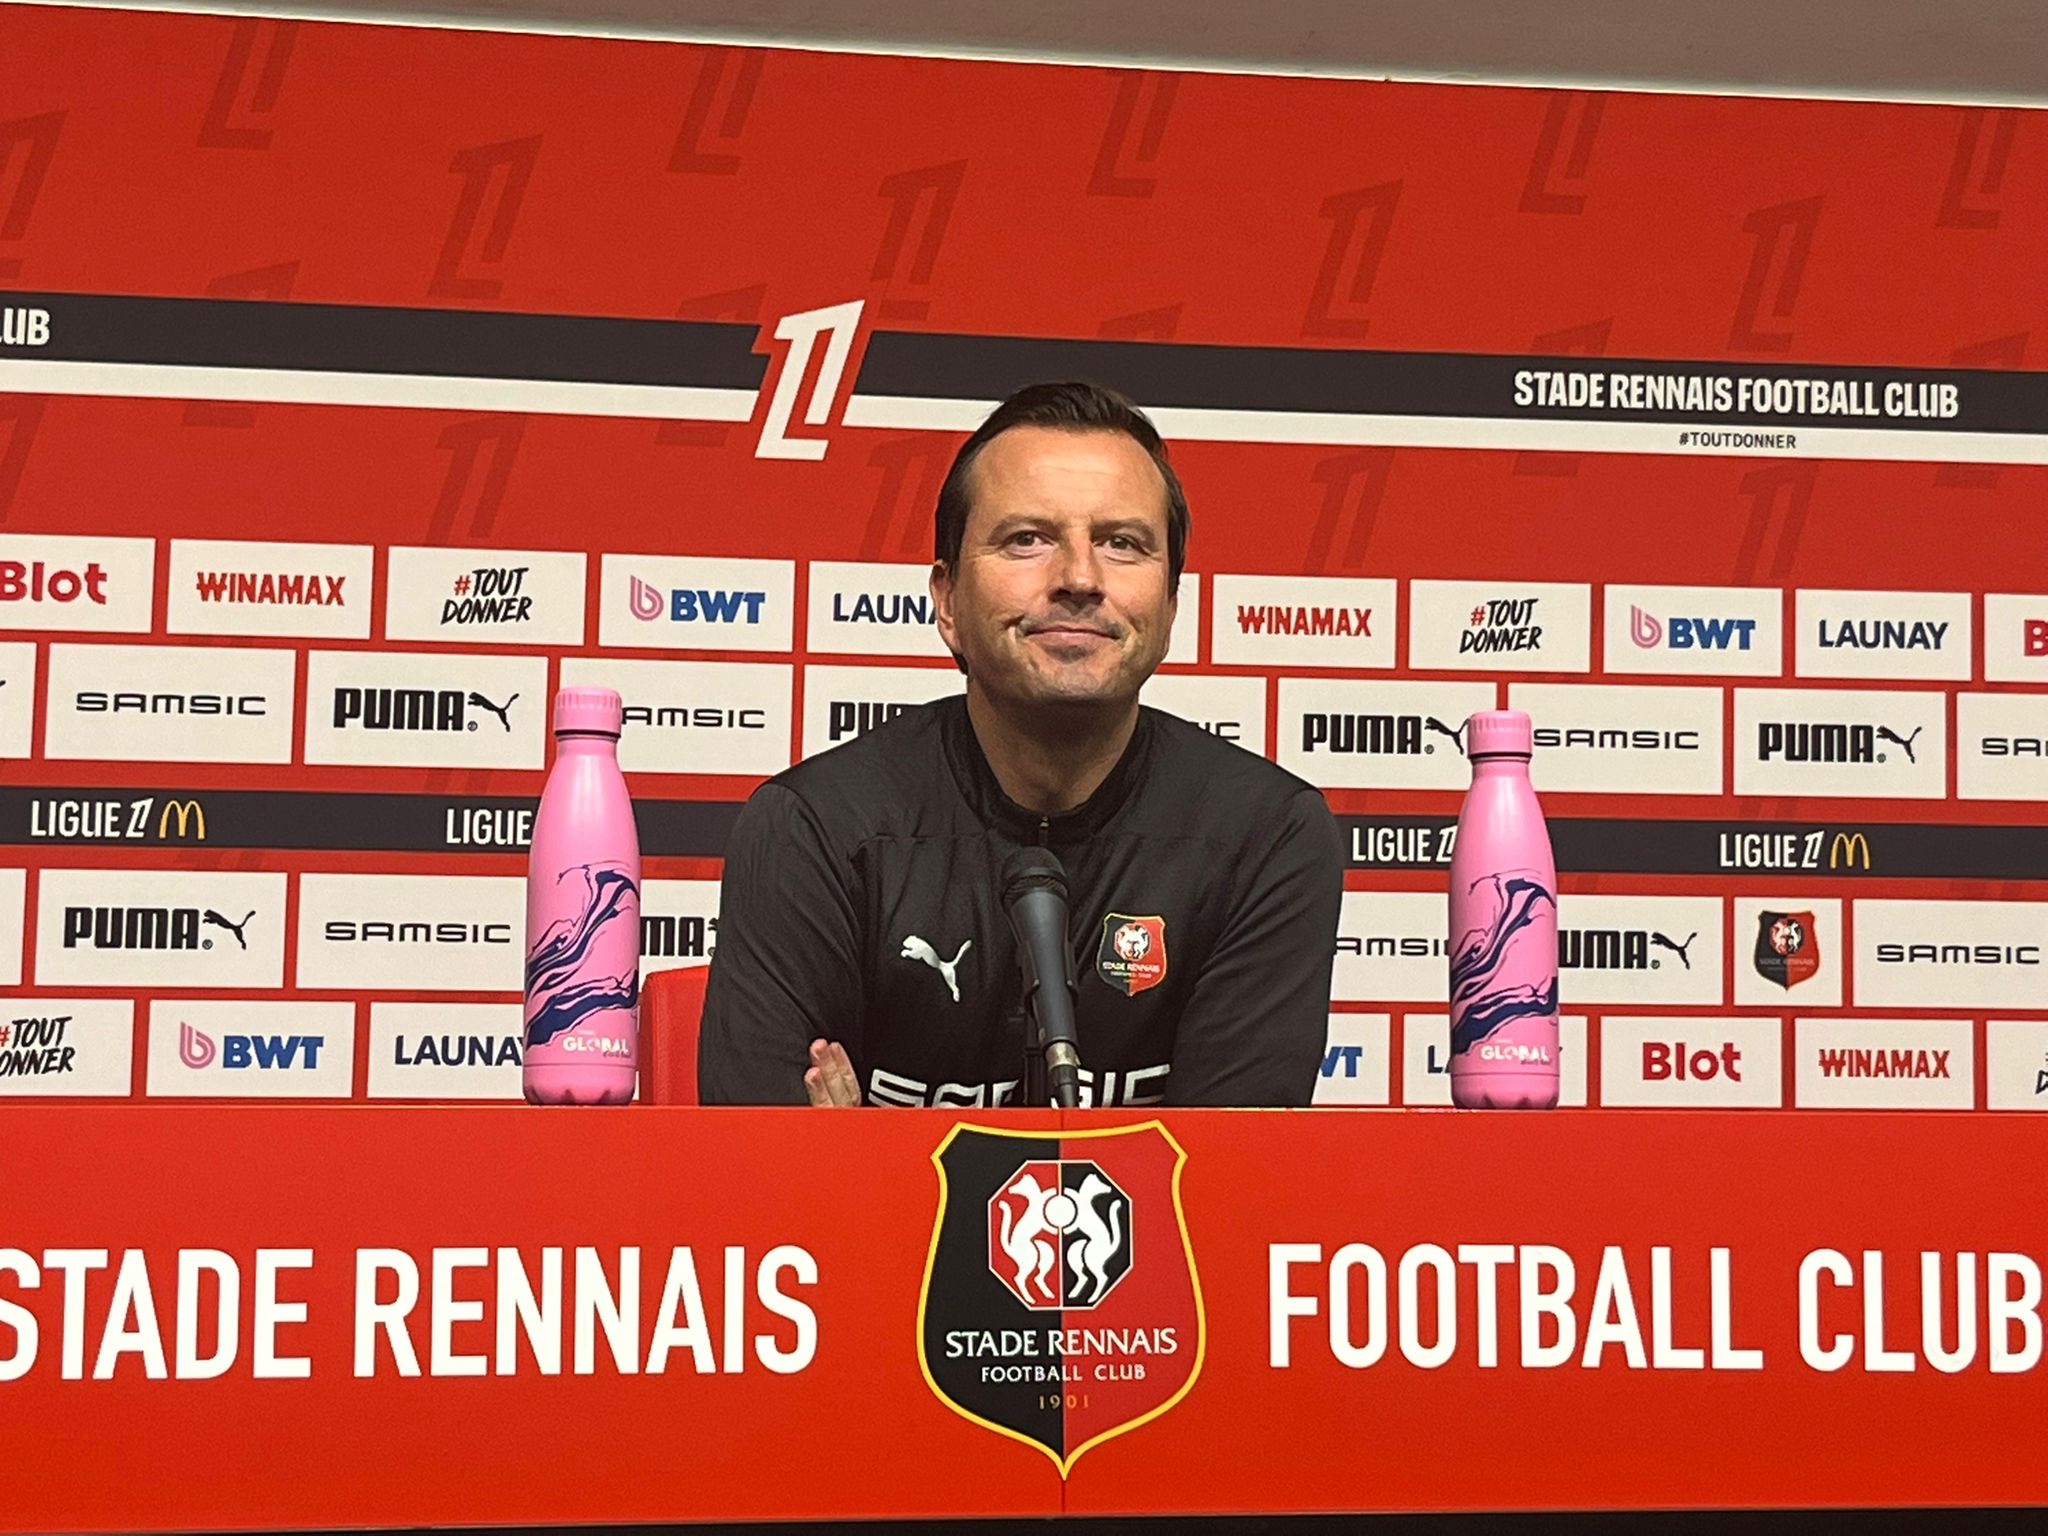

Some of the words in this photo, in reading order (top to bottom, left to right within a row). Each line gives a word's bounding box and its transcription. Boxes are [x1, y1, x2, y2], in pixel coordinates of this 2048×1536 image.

[0, 308, 50, 345] UB
[1514, 370, 1605, 408] STADE
[1609, 373, 1734, 412] RENNAIS
[1737, 377, 1880, 417] FOOTBALL
[1884, 381, 1960, 418] CLUB
[1679, 431, 1797, 450] #TOUTDONNER
[0, 561, 107, 605] Blot
[196, 571, 346, 606] WINAMAX
[454, 567, 530, 597] #TOUT
[441, 596, 532, 625] DONNER
[671, 589, 766, 624] BWT
[833, 592, 936, 624] LAUN
[1237, 605, 1372, 637] WINAMAX
[1470, 598, 1539, 628] #TOUT
[1459, 625, 1542, 653] DONNER
[1669, 617, 1756, 651] BWT
[1819, 620, 1949, 650] LAUNAY
[76, 692, 266, 715] SAMSIC
[333, 687, 464, 731] PUMA
[622, 706, 765, 728] AMSIC
[1303, 713, 1418, 754] PUMA
[1533, 728, 1699, 750] SAMSIC
[1758, 723, 1874, 763] PUMA
[31, 801, 118, 838] LIGUE
[447, 808, 532, 845] LIGUE
[1352, 827, 1432, 862] LIGUE
[1721, 833, 1797, 868] LIGUE
[63, 906, 198, 950] PUMA
[325, 921, 511, 944] SAMSIC
[1336, 936, 1449, 957] AMSI
[1558, 930, 1647, 969] UMA
[1877, 943, 2040, 965] SAMSIC
[0, 1047, 76, 1077] ONNER
[223, 1034, 325, 1070] BWT
[1643, 1042, 1742, 1083] Blot
[1819, 1048, 1951, 1079] WINAMAX
[0, 1247, 313, 1381] STADE
[354, 1244, 818, 1378] RENNAIS
[1269, 1242, 1764, 1370] FOOTBALL
[1799, 1248, 2044, 1374] CLUB
[945, 1330, 1039, 1358] STADE
[1048, 1328, 1178, 1356] RENNAIS
[981, 1366, 1082, 1382] FOOTBALL
[1094, 1364, 1146, 1380] CLUB
[1038, 1395, 1090, 1410] 1901
